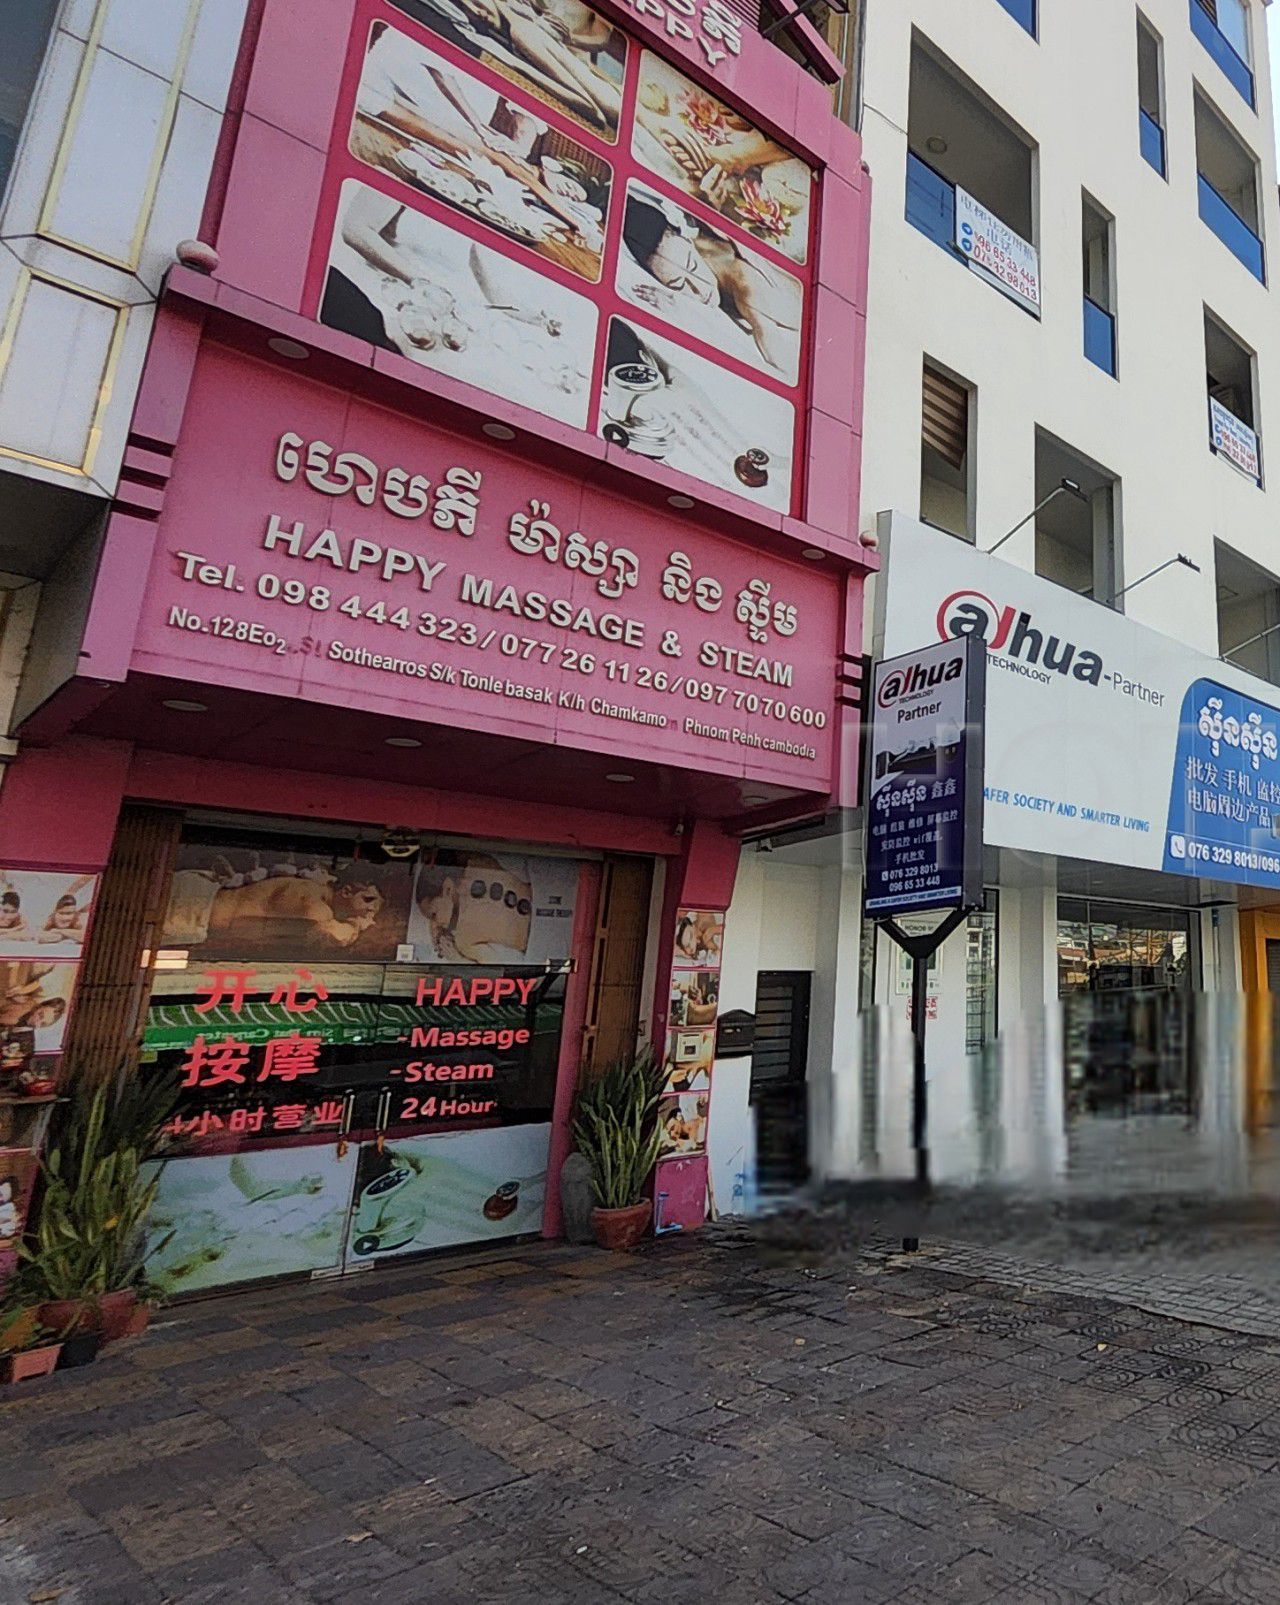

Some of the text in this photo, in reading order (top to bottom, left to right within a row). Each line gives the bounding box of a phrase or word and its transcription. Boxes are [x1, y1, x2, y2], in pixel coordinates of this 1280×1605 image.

[263, 514, 794, 687] HAPPY MASSAGE & STEAM
[661, 551, 723, 612] និង
[176, 551, 245, 592] Tel.
[257, 573, 331, 611] 098
[340, 596, 411, 630] 444
[561, 649, 596, 673] 26
[604, 660, 629, 683] 11
[986, 654, 1052, 685] TECHNOLOGY
[328, 641, 427, 678] Sothearros
[429, 662, 456, 684] S/k
[460, 669, 502, 694] Tonle
[505, 681, 553, 704] basak
[558, 690, 585, 711] K/h
[685, 718, 730, 742] Phnom
[732, 728, 761, 747] Penh
[762, 735, 816, 760] cambodia
[897, 701, 942, 724] Partner
[931, 778, 957, 799] 鑫鑫
[1185, 755, 1219, 788] 批发
[1222, 769, 1252, 797] 手机
[1013, 793, 1055, 813] SOCIETY
[1057, 802, 1077, 817] AND
[1080, 807, 1122, 827] SMARTER
[1123, 816, 1150, 833] LIVING
[1187, 787, 1271, 829] 电脑周边产品
[1188, 842, 1210, 861] 076
[1211, 846, 1233, 865] 329
[194, 968, 329, 1013] 开心
[415, 977, 538, 1007] HAPPY
[179, 1032, 322, 1088] 按摩
